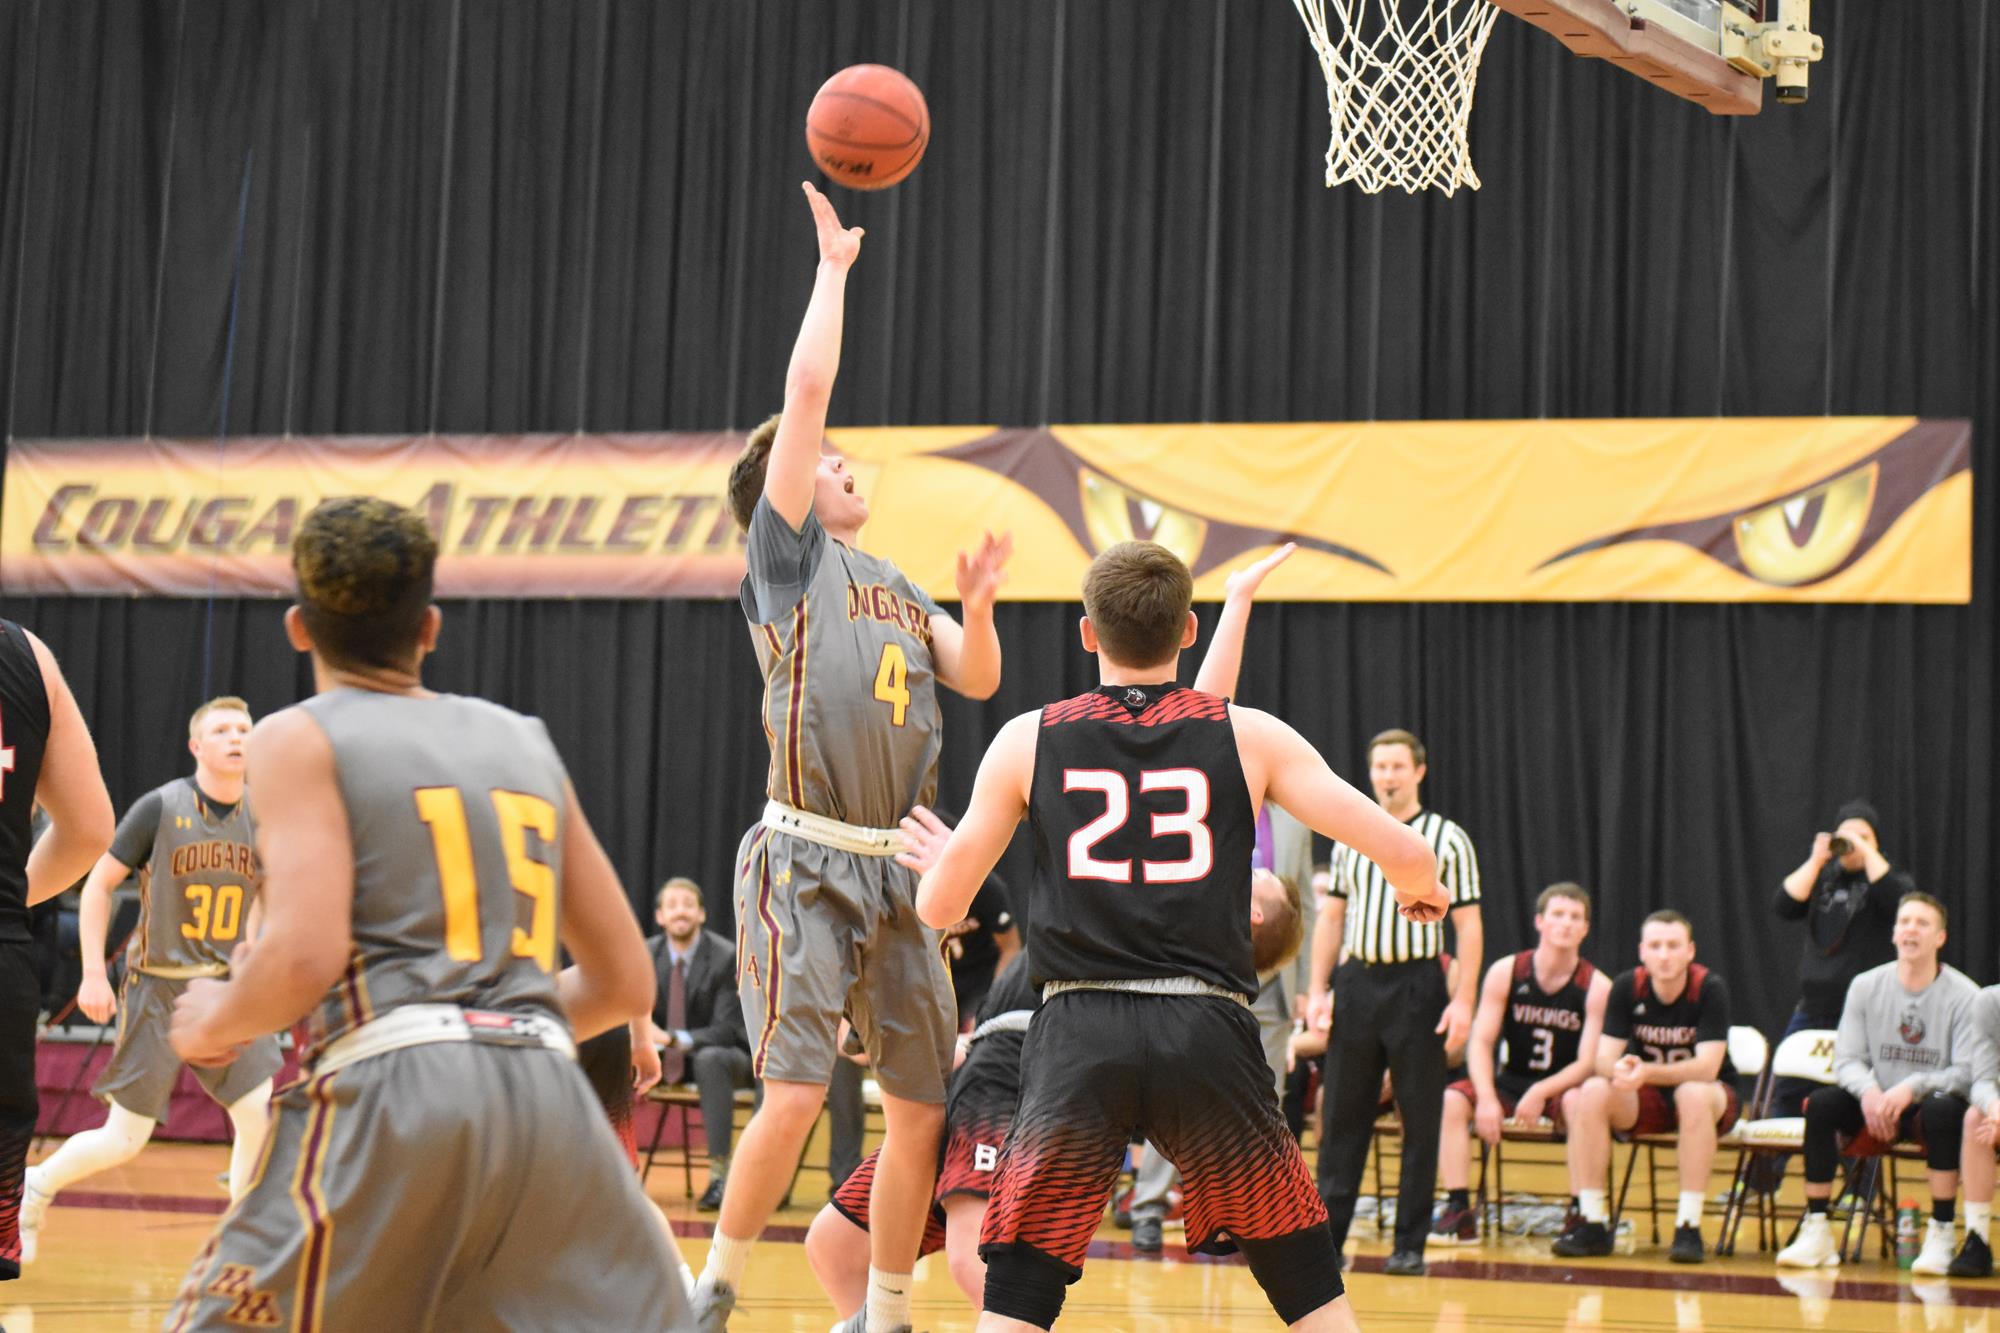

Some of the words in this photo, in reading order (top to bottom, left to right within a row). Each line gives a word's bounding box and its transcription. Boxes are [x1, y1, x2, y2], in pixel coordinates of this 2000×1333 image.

[32, 484, 306, 549] COUGA
[412, 482, 748, 549] ATHLETI
[873, 641, 911, 728] 4
[1063, 767, 1214, 884] 23
[413, 785, 558, 974] 15
[180, 883, 245, 941] 30
[1512, 1003, 1582, 1031] VIKINGS
[1528, 1028, 1554, 1070] 3
[974, 1143, 997, 1172] B
